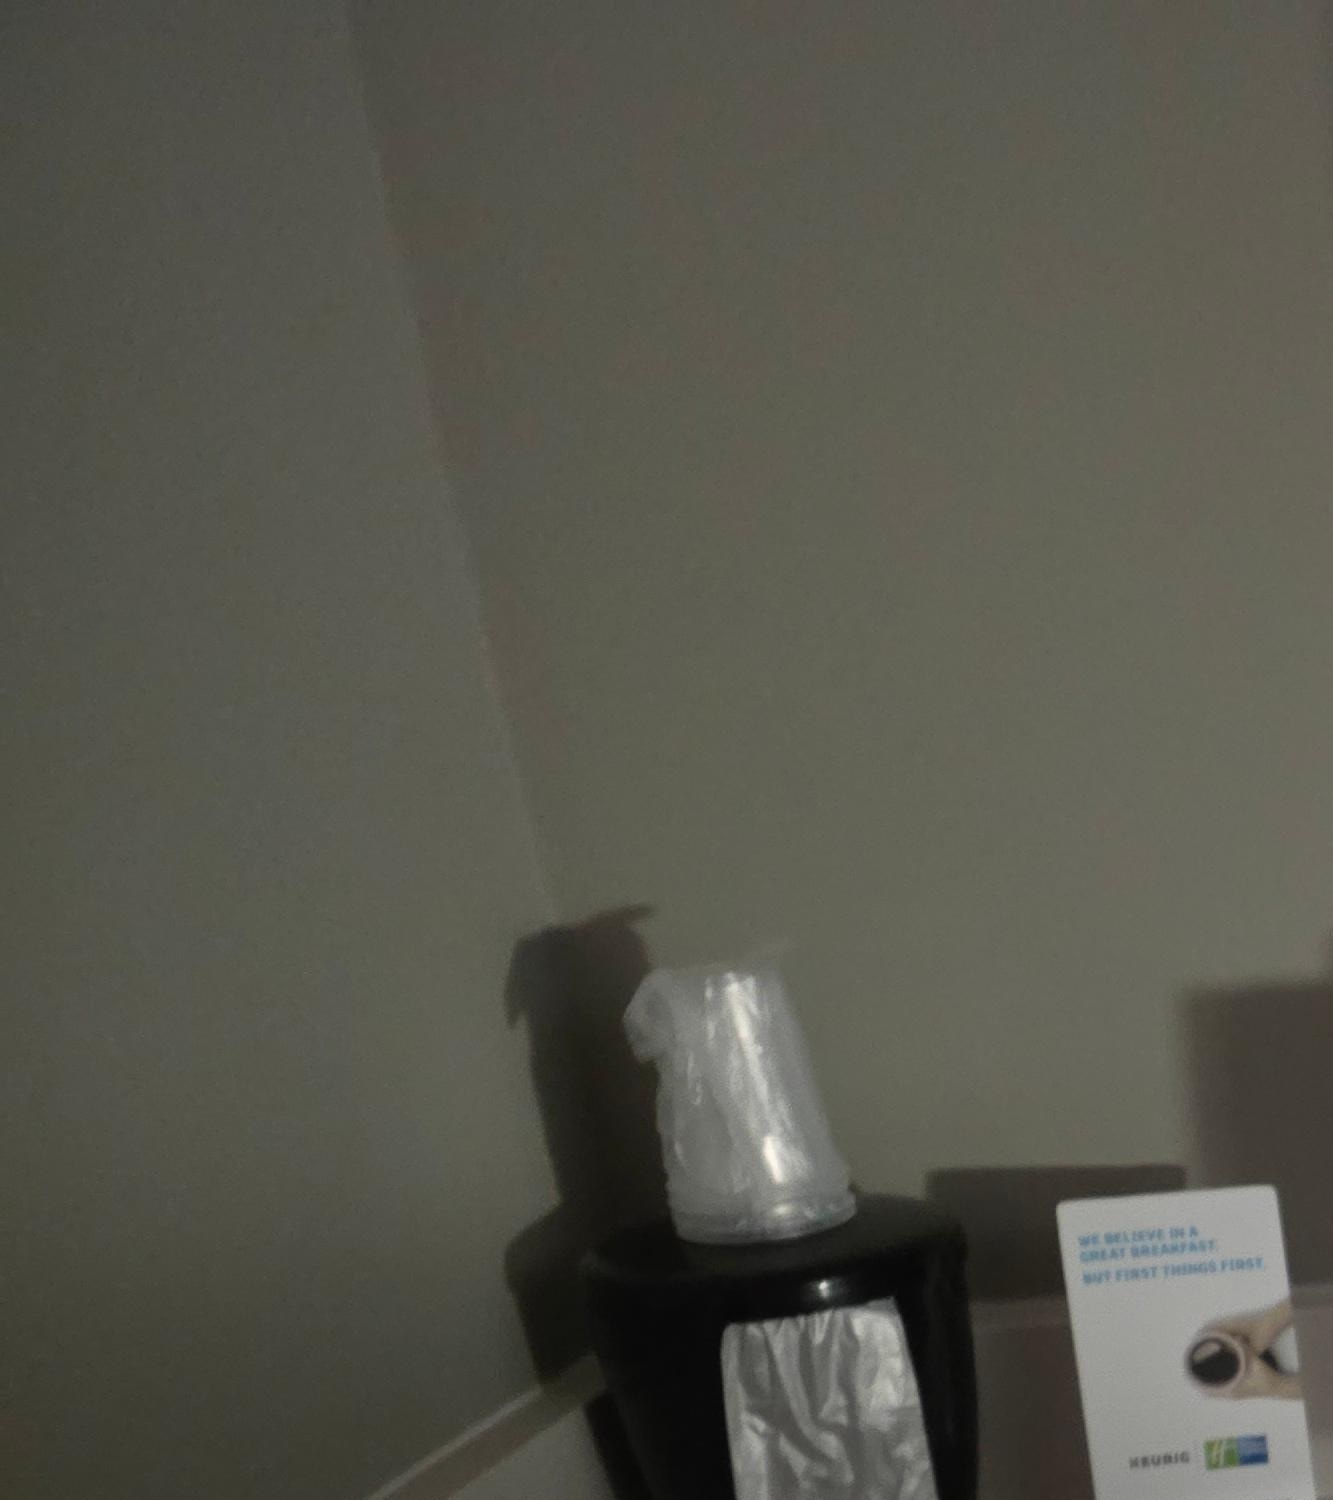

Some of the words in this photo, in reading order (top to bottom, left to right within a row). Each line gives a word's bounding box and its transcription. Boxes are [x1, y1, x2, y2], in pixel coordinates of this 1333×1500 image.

[1104, 1228, 1164, 1245] BELIEVE
[1169, 1226, 1185, 1239] IN
[1189, 1225, 1199, 1238] A
[1079, 1248, 1125, 1263] GREAT
[1082, 1267, 1111, 1285] BUT
[1115, 1264, 1157, 1281] FIRST
[1163, 1259, 1217, 1278] THINGS
[1129, 1451, 1191, 1470] KEURIG
